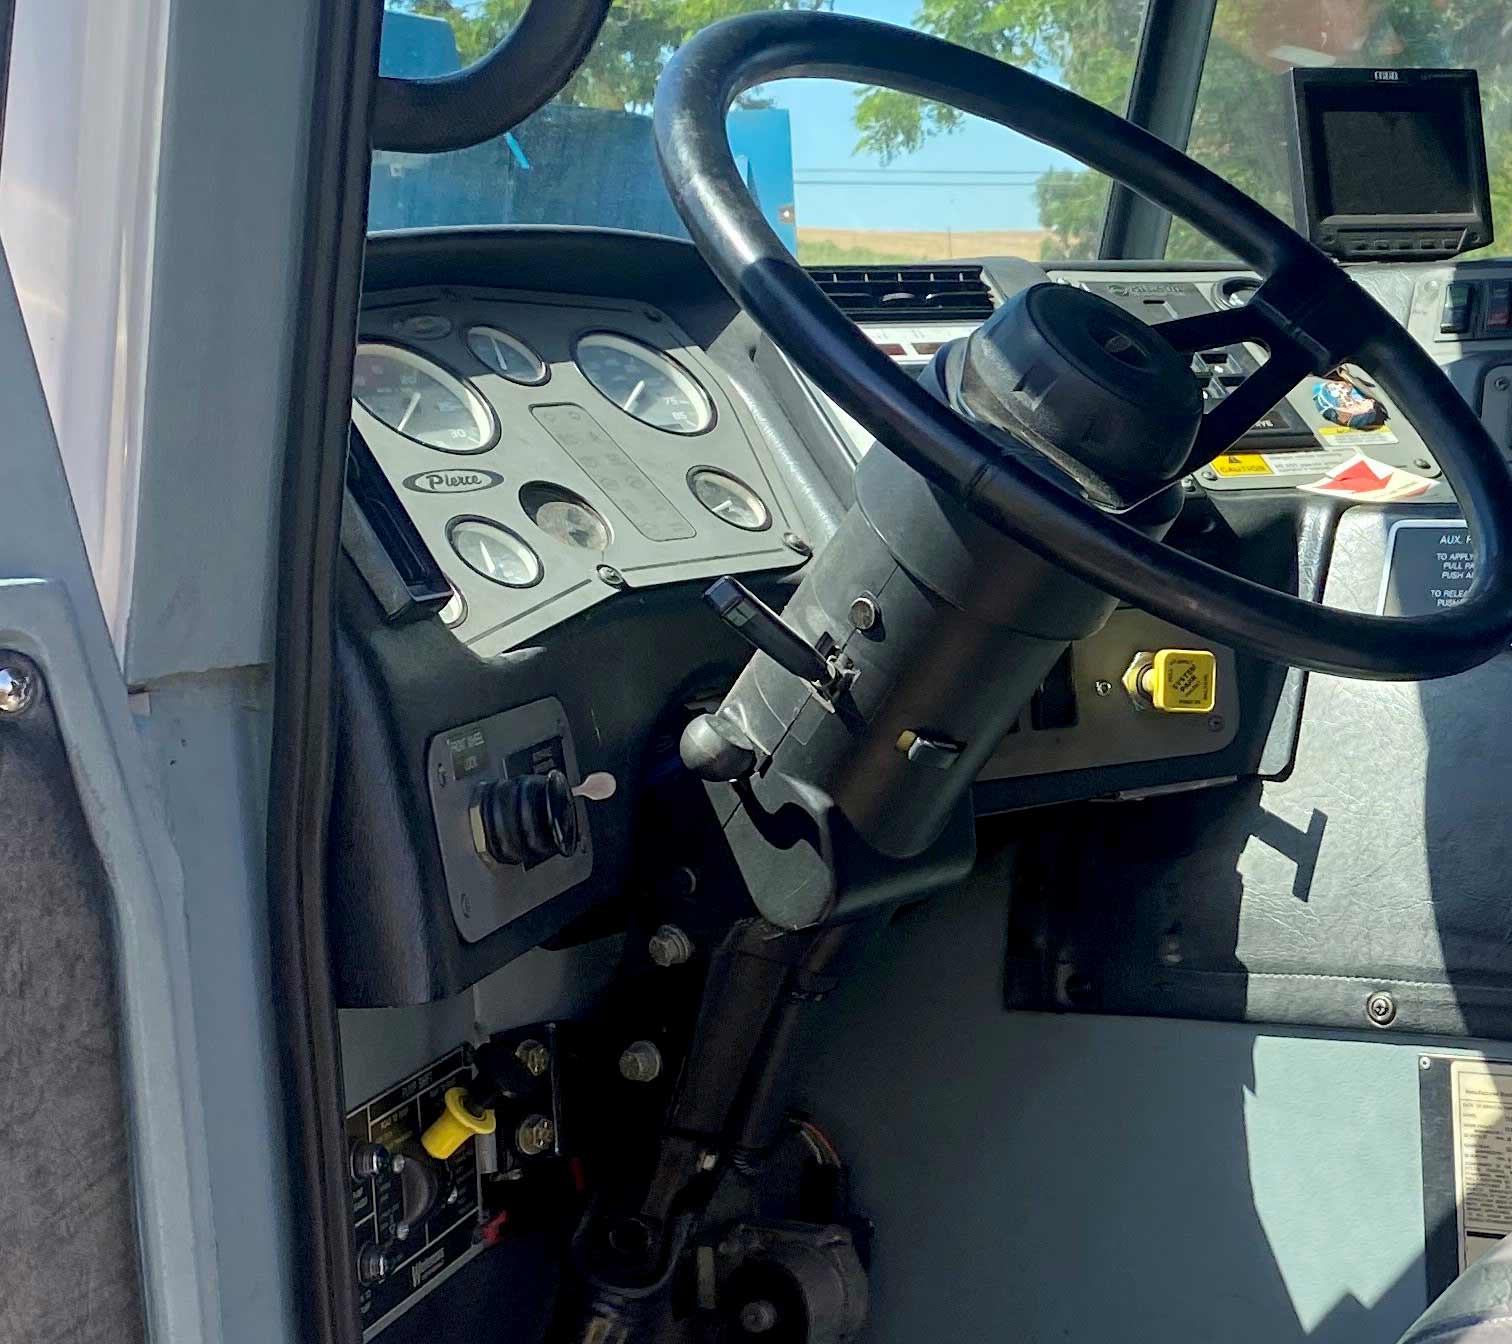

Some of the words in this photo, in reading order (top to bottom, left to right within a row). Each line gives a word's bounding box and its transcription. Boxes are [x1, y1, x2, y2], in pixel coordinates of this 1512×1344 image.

[449, 429, 467, 439] 30
[426, 474, 483, 490] Pierce
[1436, 552, 1448, 561] TO
[1430, 589, 1442, 598] TO
